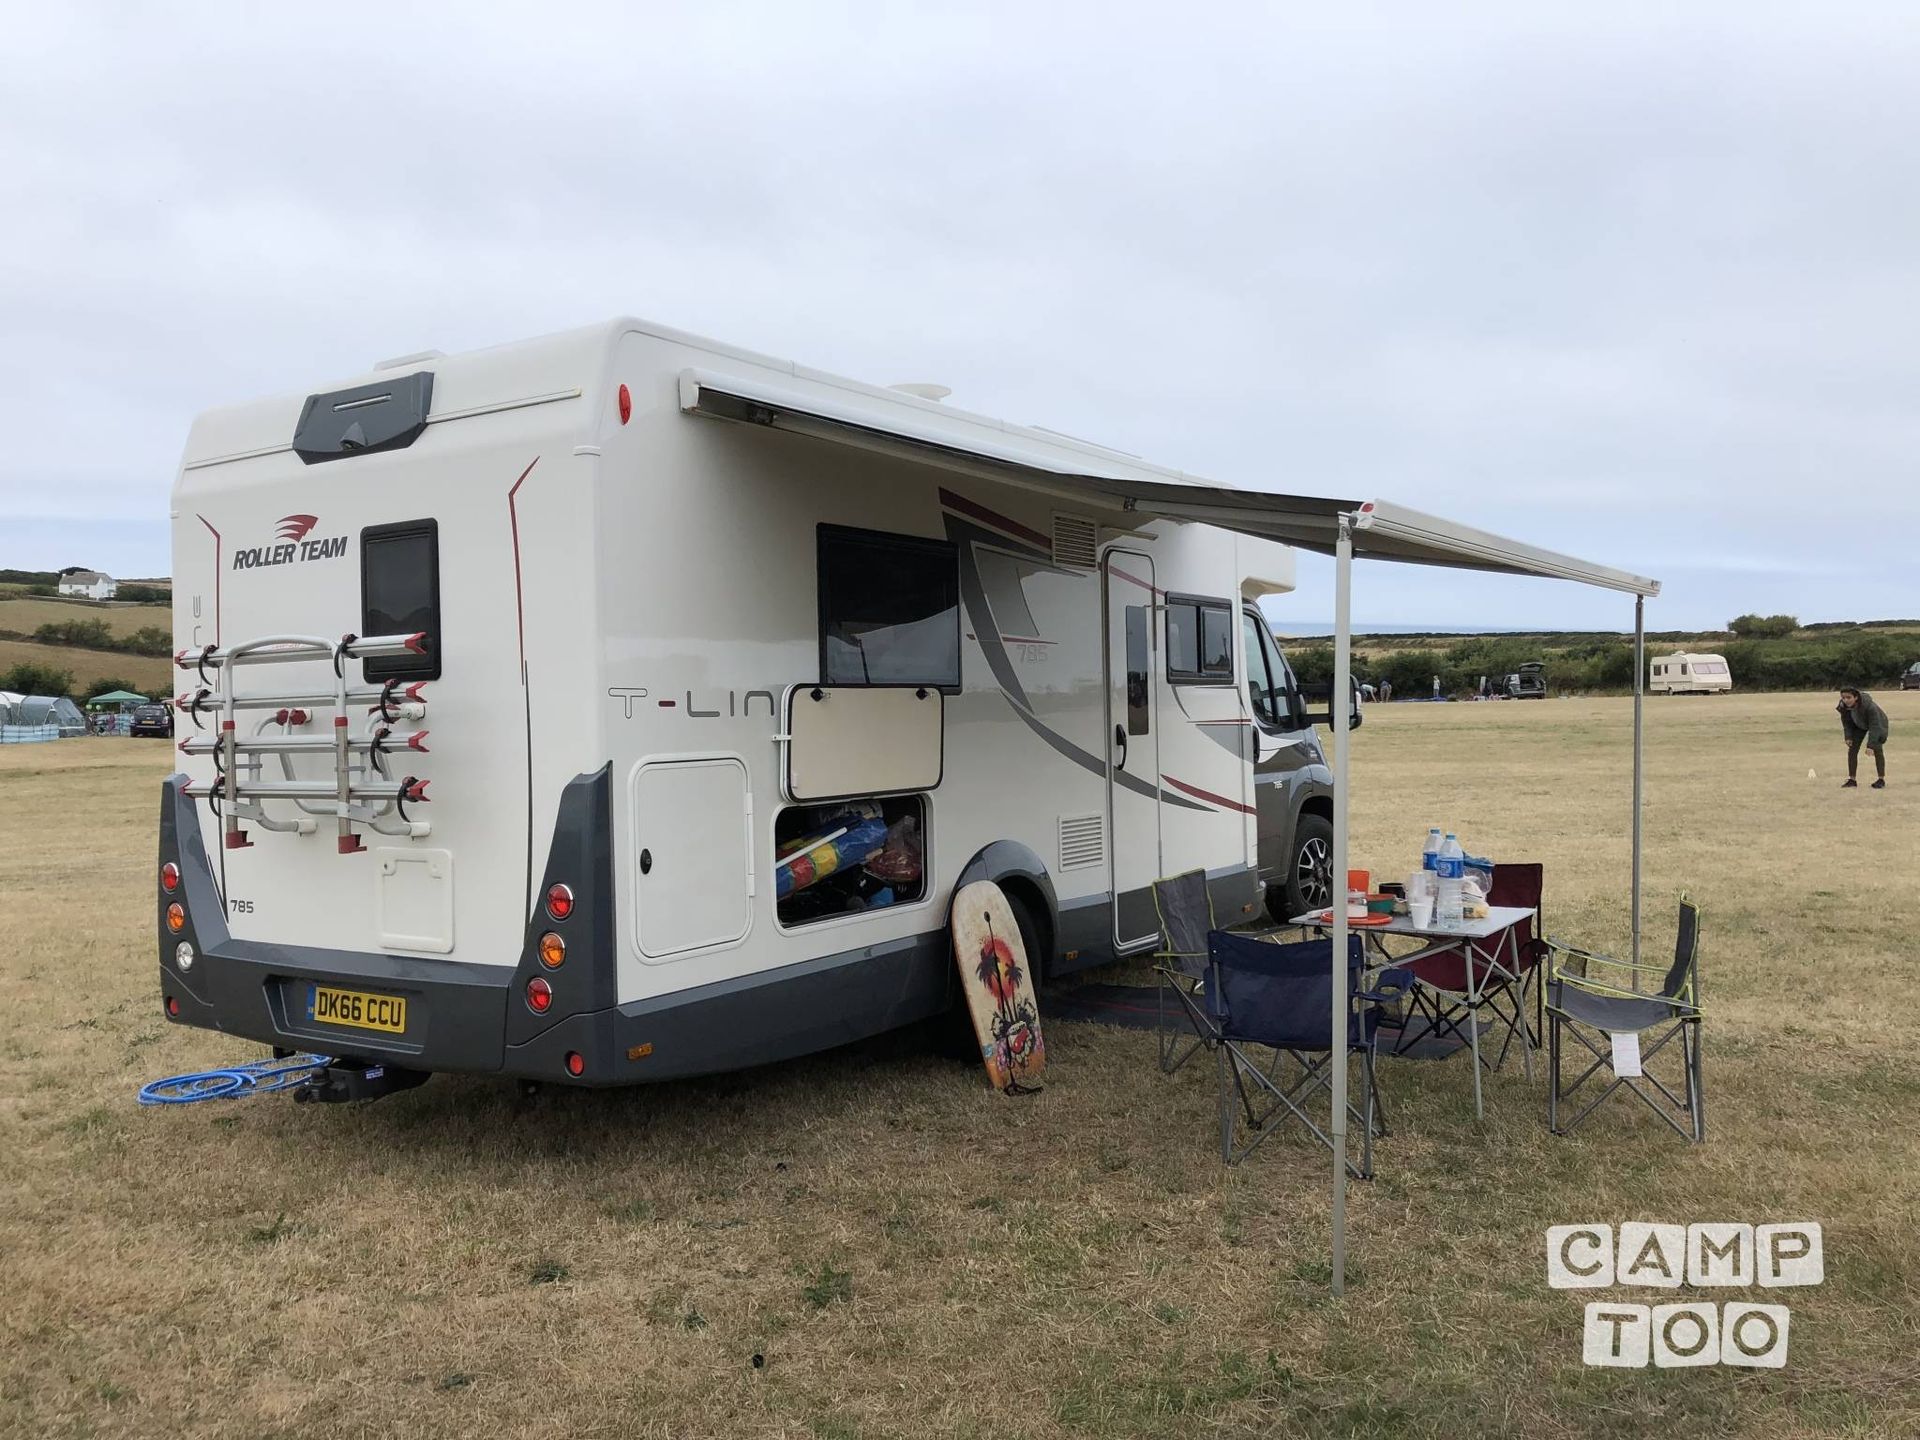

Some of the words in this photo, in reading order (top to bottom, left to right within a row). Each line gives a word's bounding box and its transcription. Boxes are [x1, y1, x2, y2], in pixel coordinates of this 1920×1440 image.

[232, 543, 297, 570] ROLLER
[300, 536, 348, 562] TEAM
[230, 899, 254, 914] 785
[317, 991, 363, 1022] DK66
[367, 998, 403, 1028] CCU
